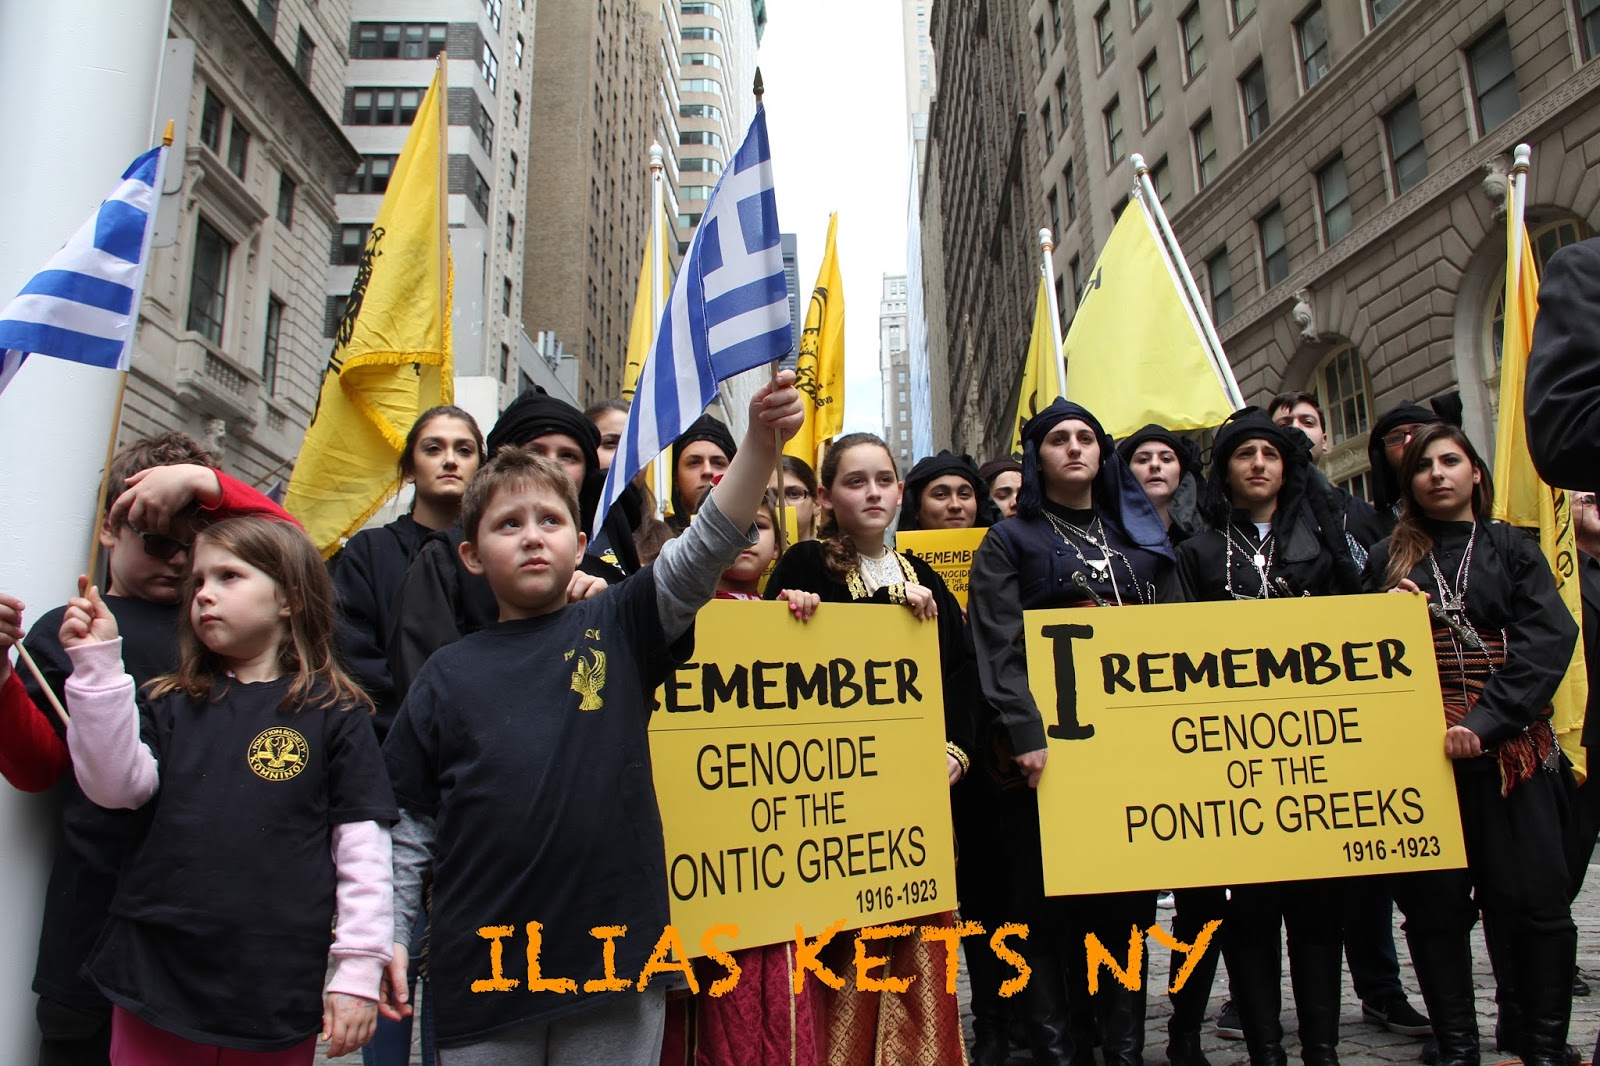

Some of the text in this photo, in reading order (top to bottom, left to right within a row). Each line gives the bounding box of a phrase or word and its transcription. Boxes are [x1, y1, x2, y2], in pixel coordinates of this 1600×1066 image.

[917, 550, 976, 564] REMEMB
[953, 584, 969, 592] GRE
[652, 658, 923, 713] EMEMBER
[1041, 624, 1412, 740] I REMEMBER
[284, 730, 306, 752] SOCIETY
[1171, 707, 1362, 754] GENOCIDE
[696, 735, 878, 790] GENOCIDE
[1227, 755, 1328, 789] OF THE
[751, 790, 847, 833] OF THE
[1125, 787, 1424, 843] PONTIC GREEKS
[670, 825, 926, 901] ONTIC GREEKS
